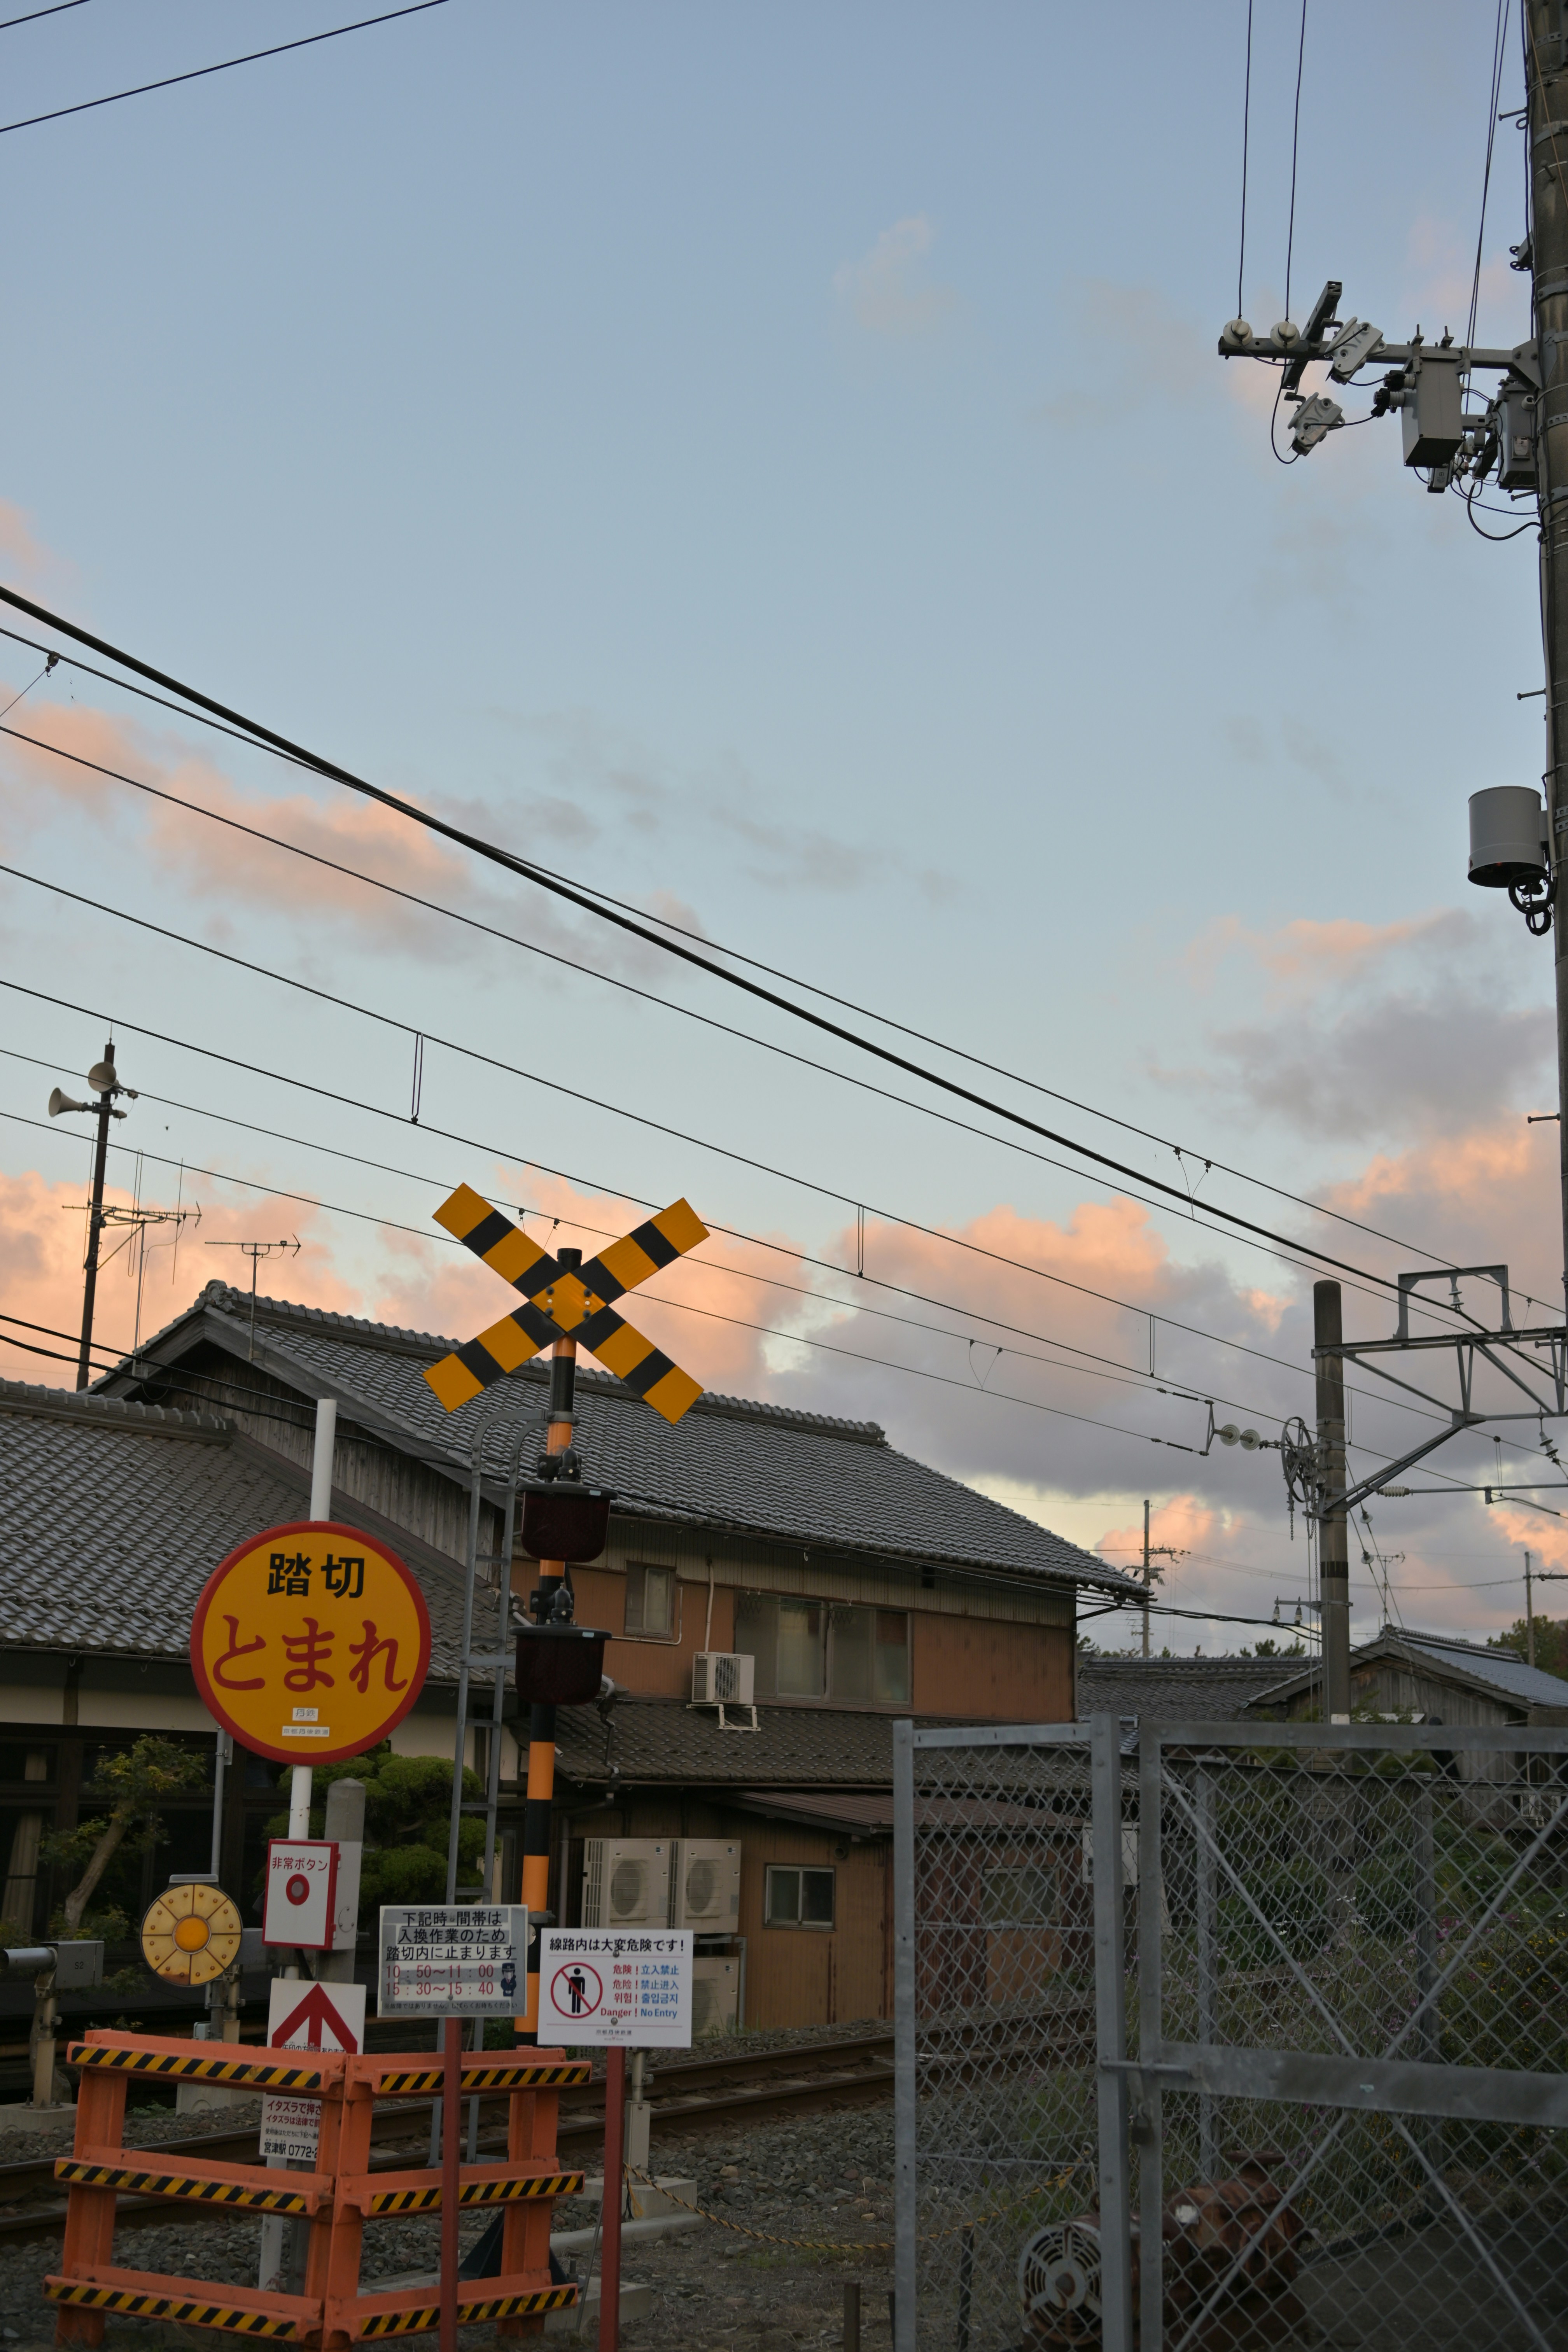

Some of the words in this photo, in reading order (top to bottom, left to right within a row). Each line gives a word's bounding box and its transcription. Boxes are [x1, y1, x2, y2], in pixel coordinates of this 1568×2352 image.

[267, 1553, 365, 1598] 踏切
[213, 1615, 408, 1693] とまれ
[272, 1857, 327, 1871] 非常ボタン
[398, 1928, 506, 1943] 入換作業のため
[550, 1937, 684, 1952] 線路内は大変危険です！
[386, 1945, 516, 1960] 踏切内に止まります
[641, 2008, 653, 2016] No
[654, 2008, 677, 2019] Entry
[264, 2142, 286, 2154] 宮津駅
